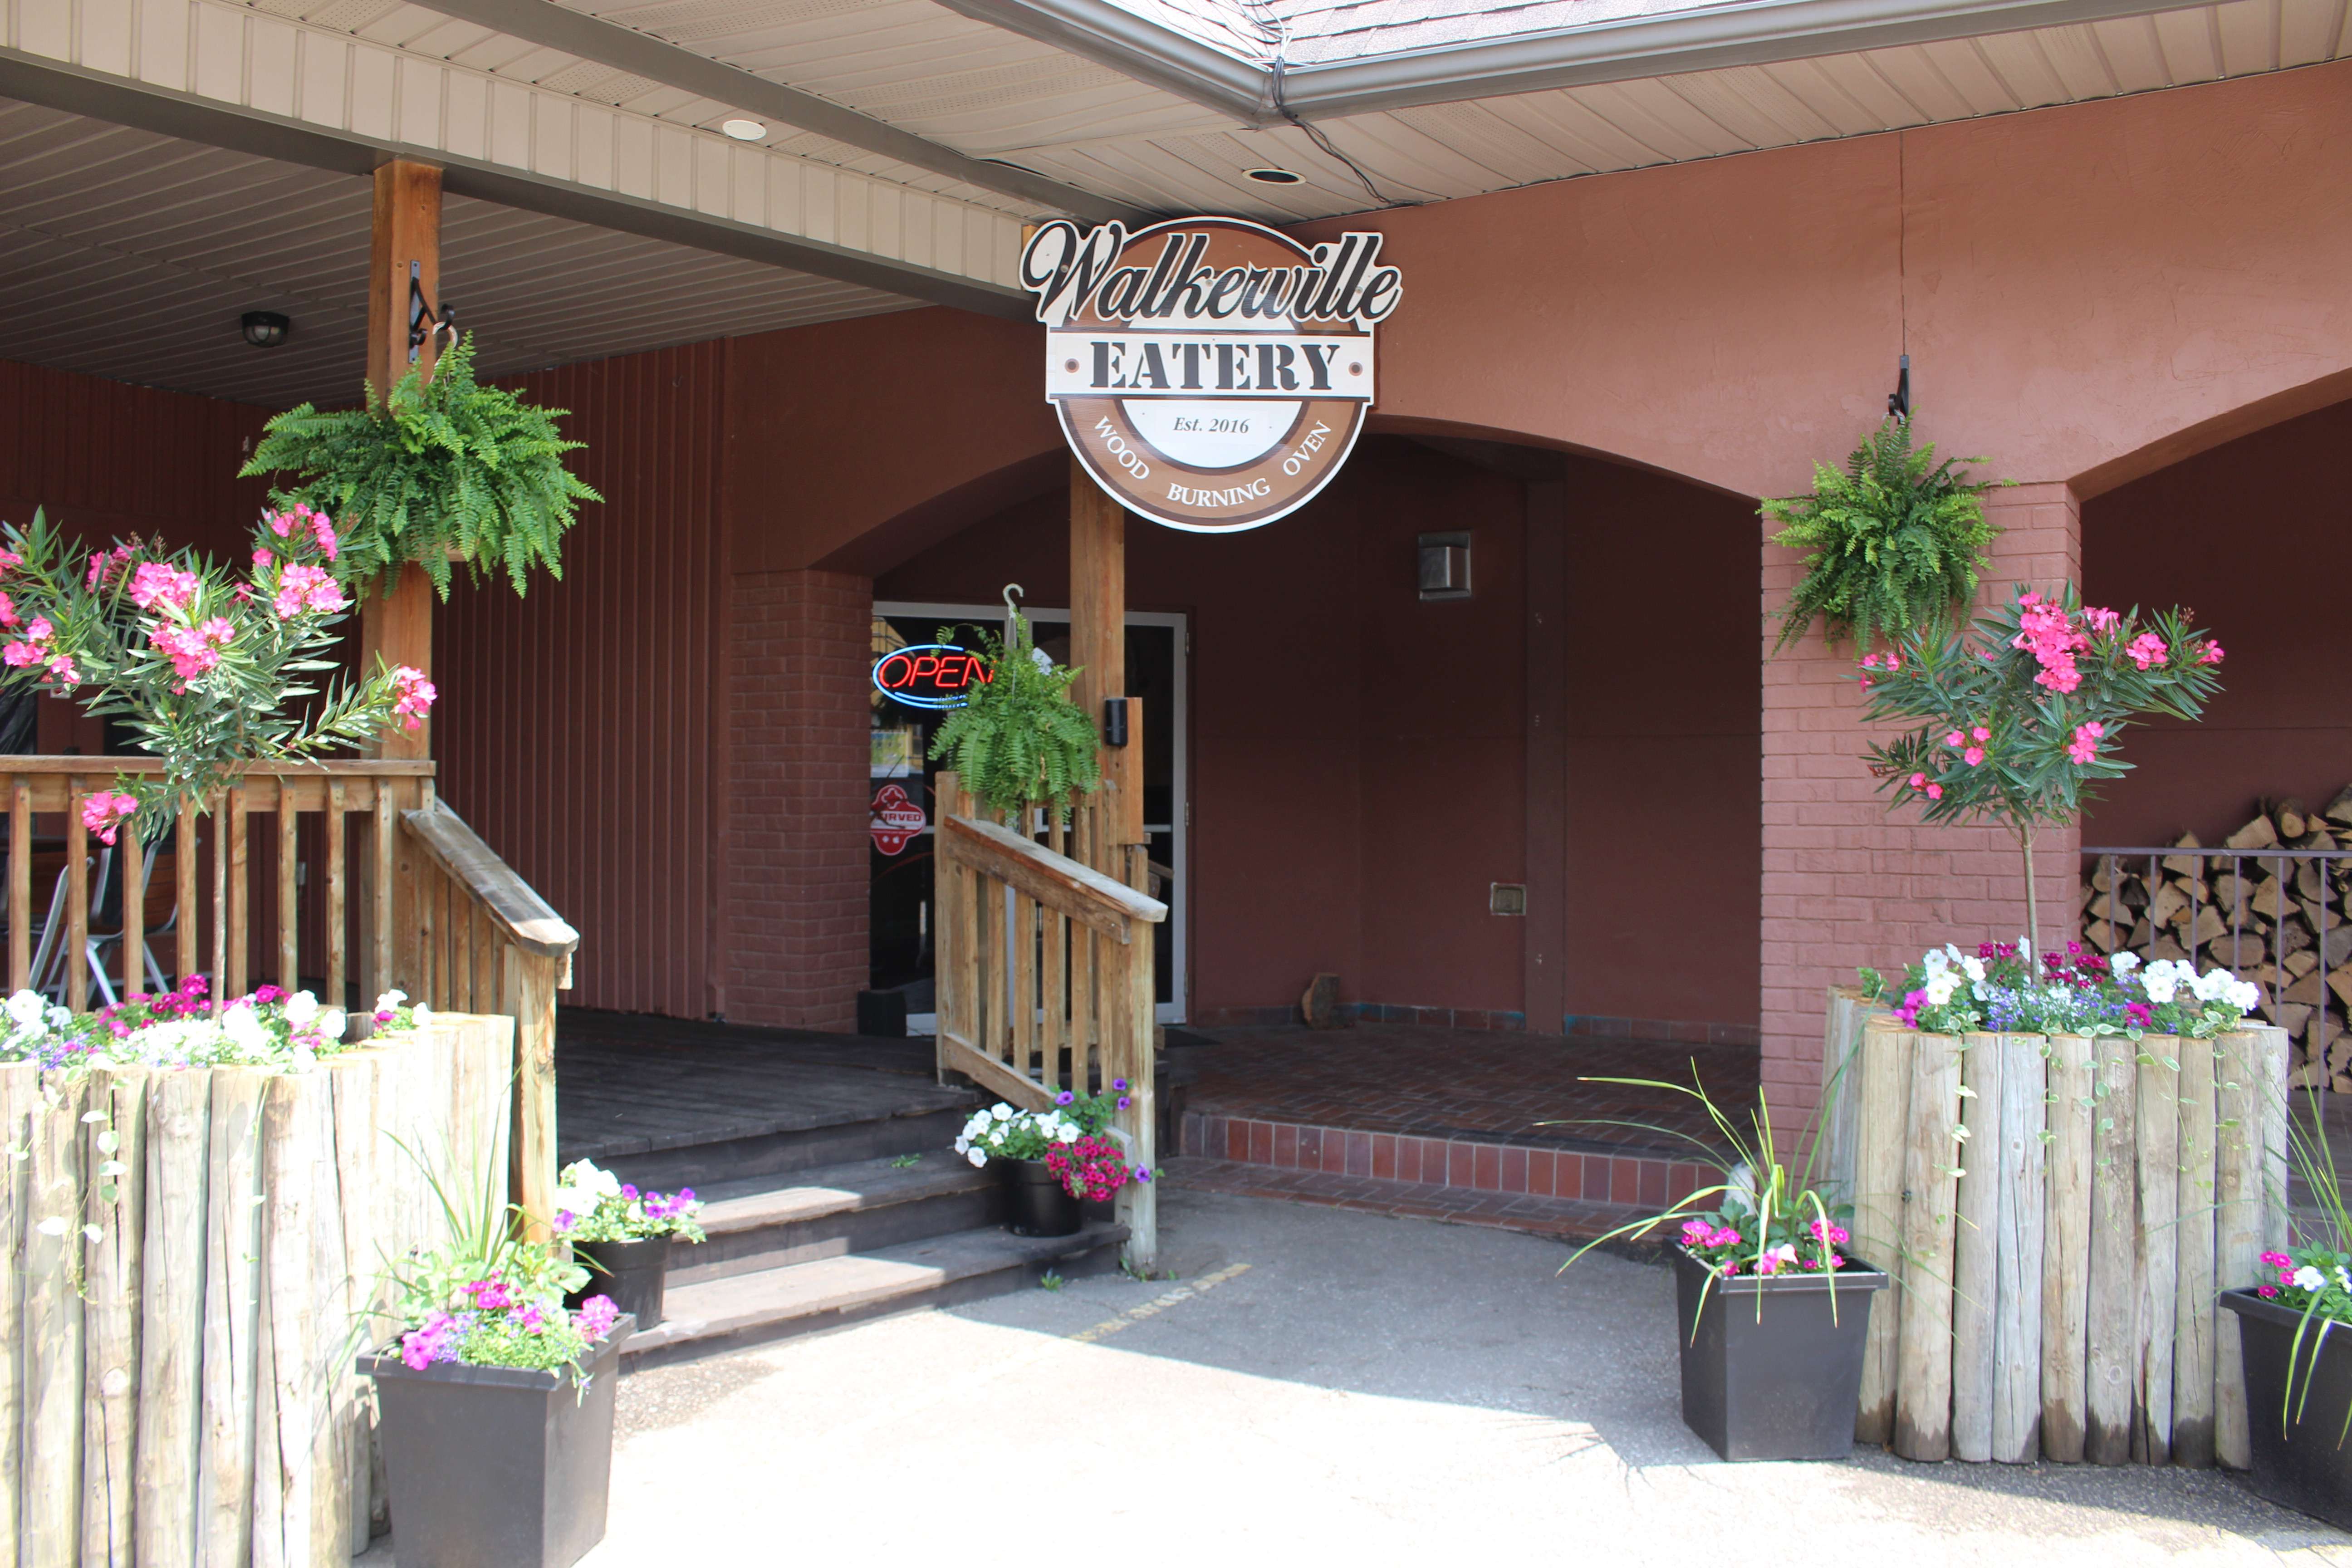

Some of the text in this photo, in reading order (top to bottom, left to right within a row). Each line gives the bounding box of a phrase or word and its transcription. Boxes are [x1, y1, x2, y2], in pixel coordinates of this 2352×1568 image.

[1023, 223, 1400, 320] Walkerville
[1090, 342, 1340, 391] EATERY
[1173, 416, 1250, 434] Est. 2016
[1094, 416, 1333, 507] WOOD BURNING OVEN
[878, 655, 996, 687] OPEN
